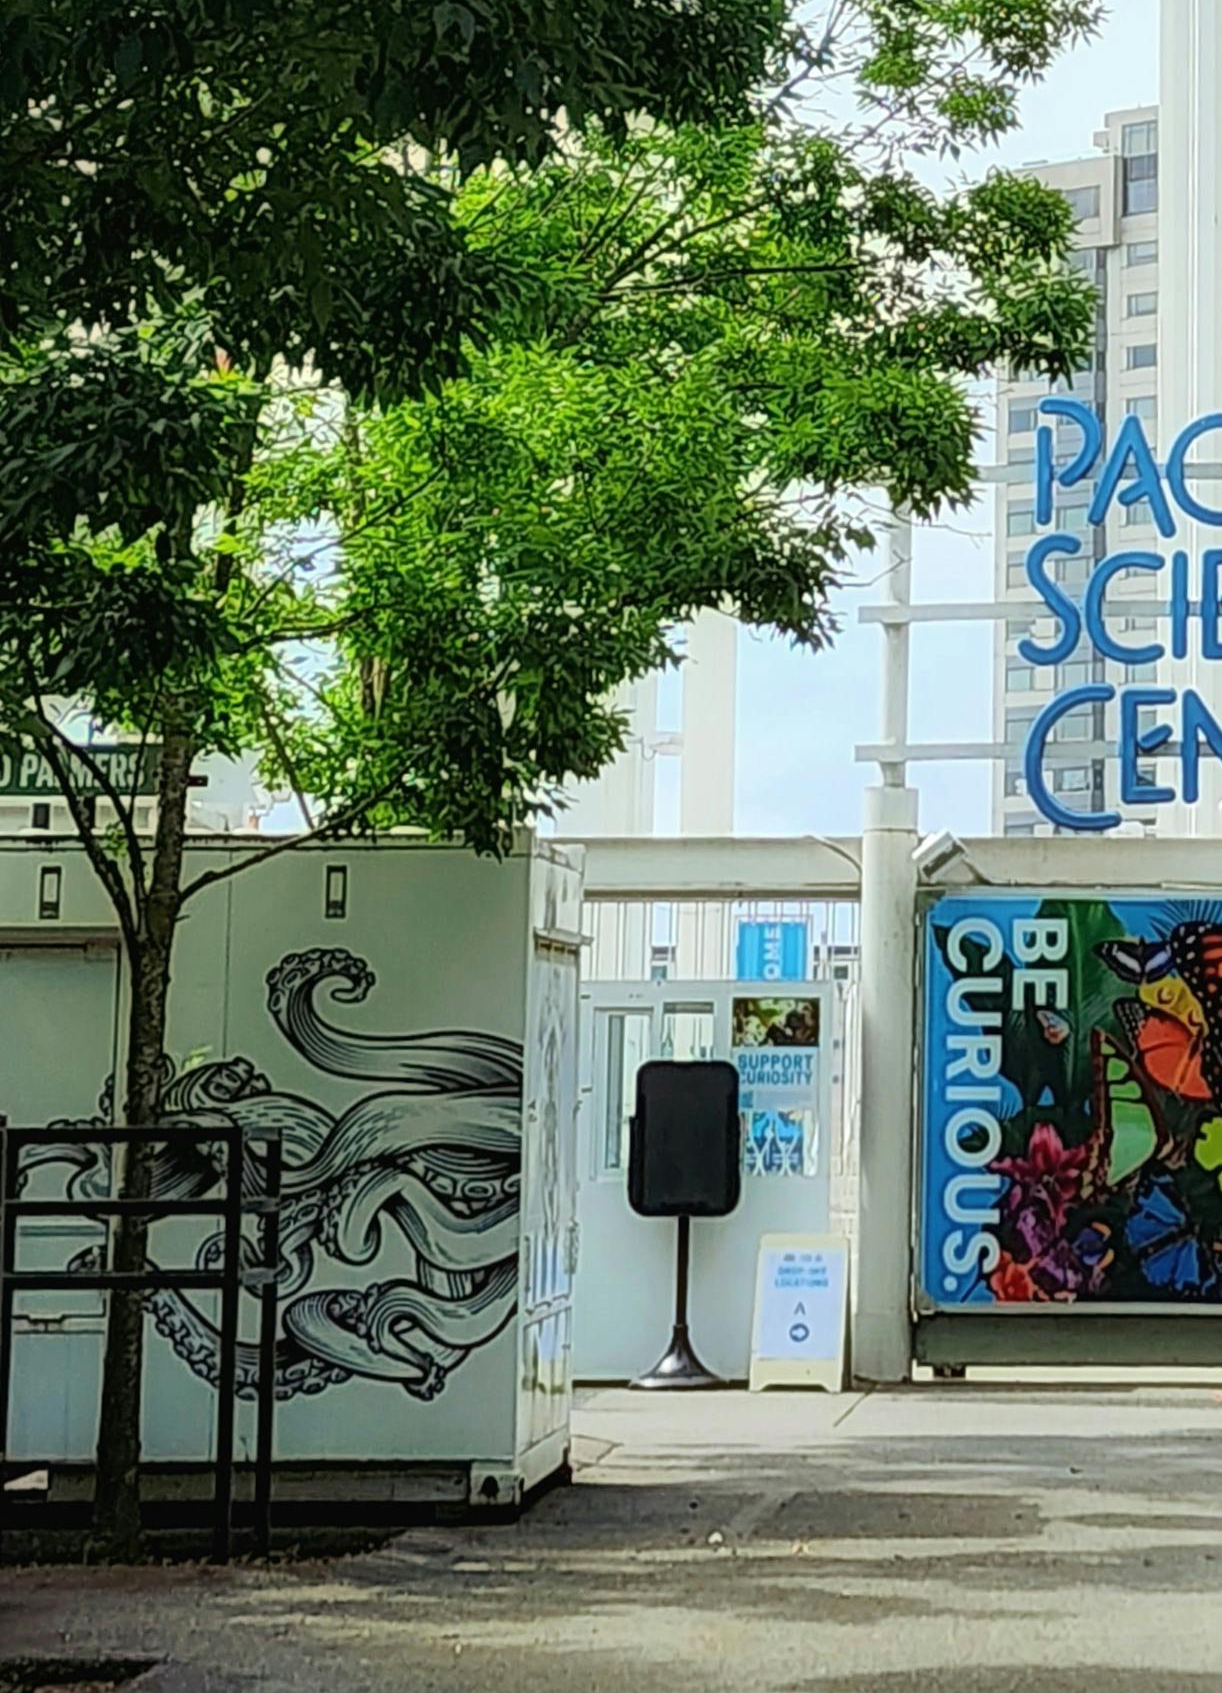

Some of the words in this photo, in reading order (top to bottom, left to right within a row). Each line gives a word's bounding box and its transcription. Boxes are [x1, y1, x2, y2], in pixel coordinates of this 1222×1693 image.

[1012, 918, 1069, 1011] BE
[738, 1054, 814, 1069] SUPPORT
[943, 917, 1005, 1292] CURIOUS.
